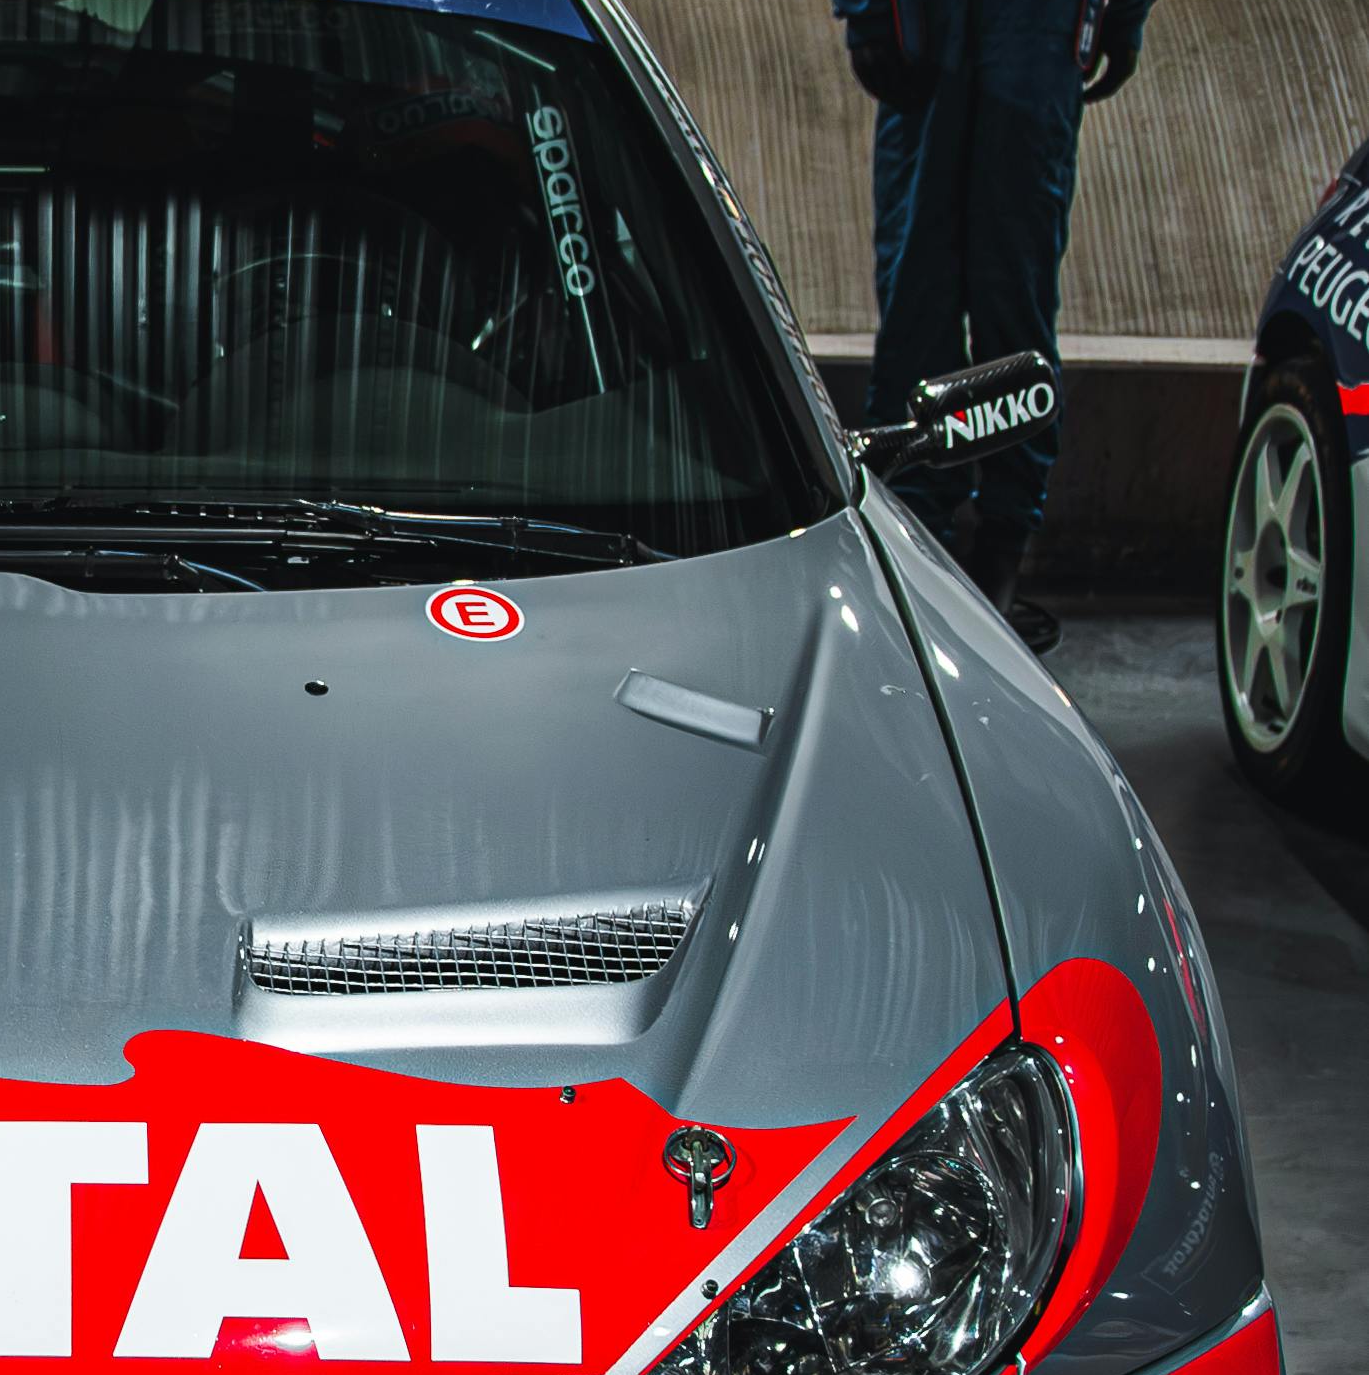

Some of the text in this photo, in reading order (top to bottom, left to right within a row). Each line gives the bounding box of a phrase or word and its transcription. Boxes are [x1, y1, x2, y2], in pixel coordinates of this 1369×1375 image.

[533, 105, 595, 297] sparco
[1287, 234, 1369, 353] PEUGE
[945, 383, 1055, 449] NIKKO
[455, 602, 495, 626] E
